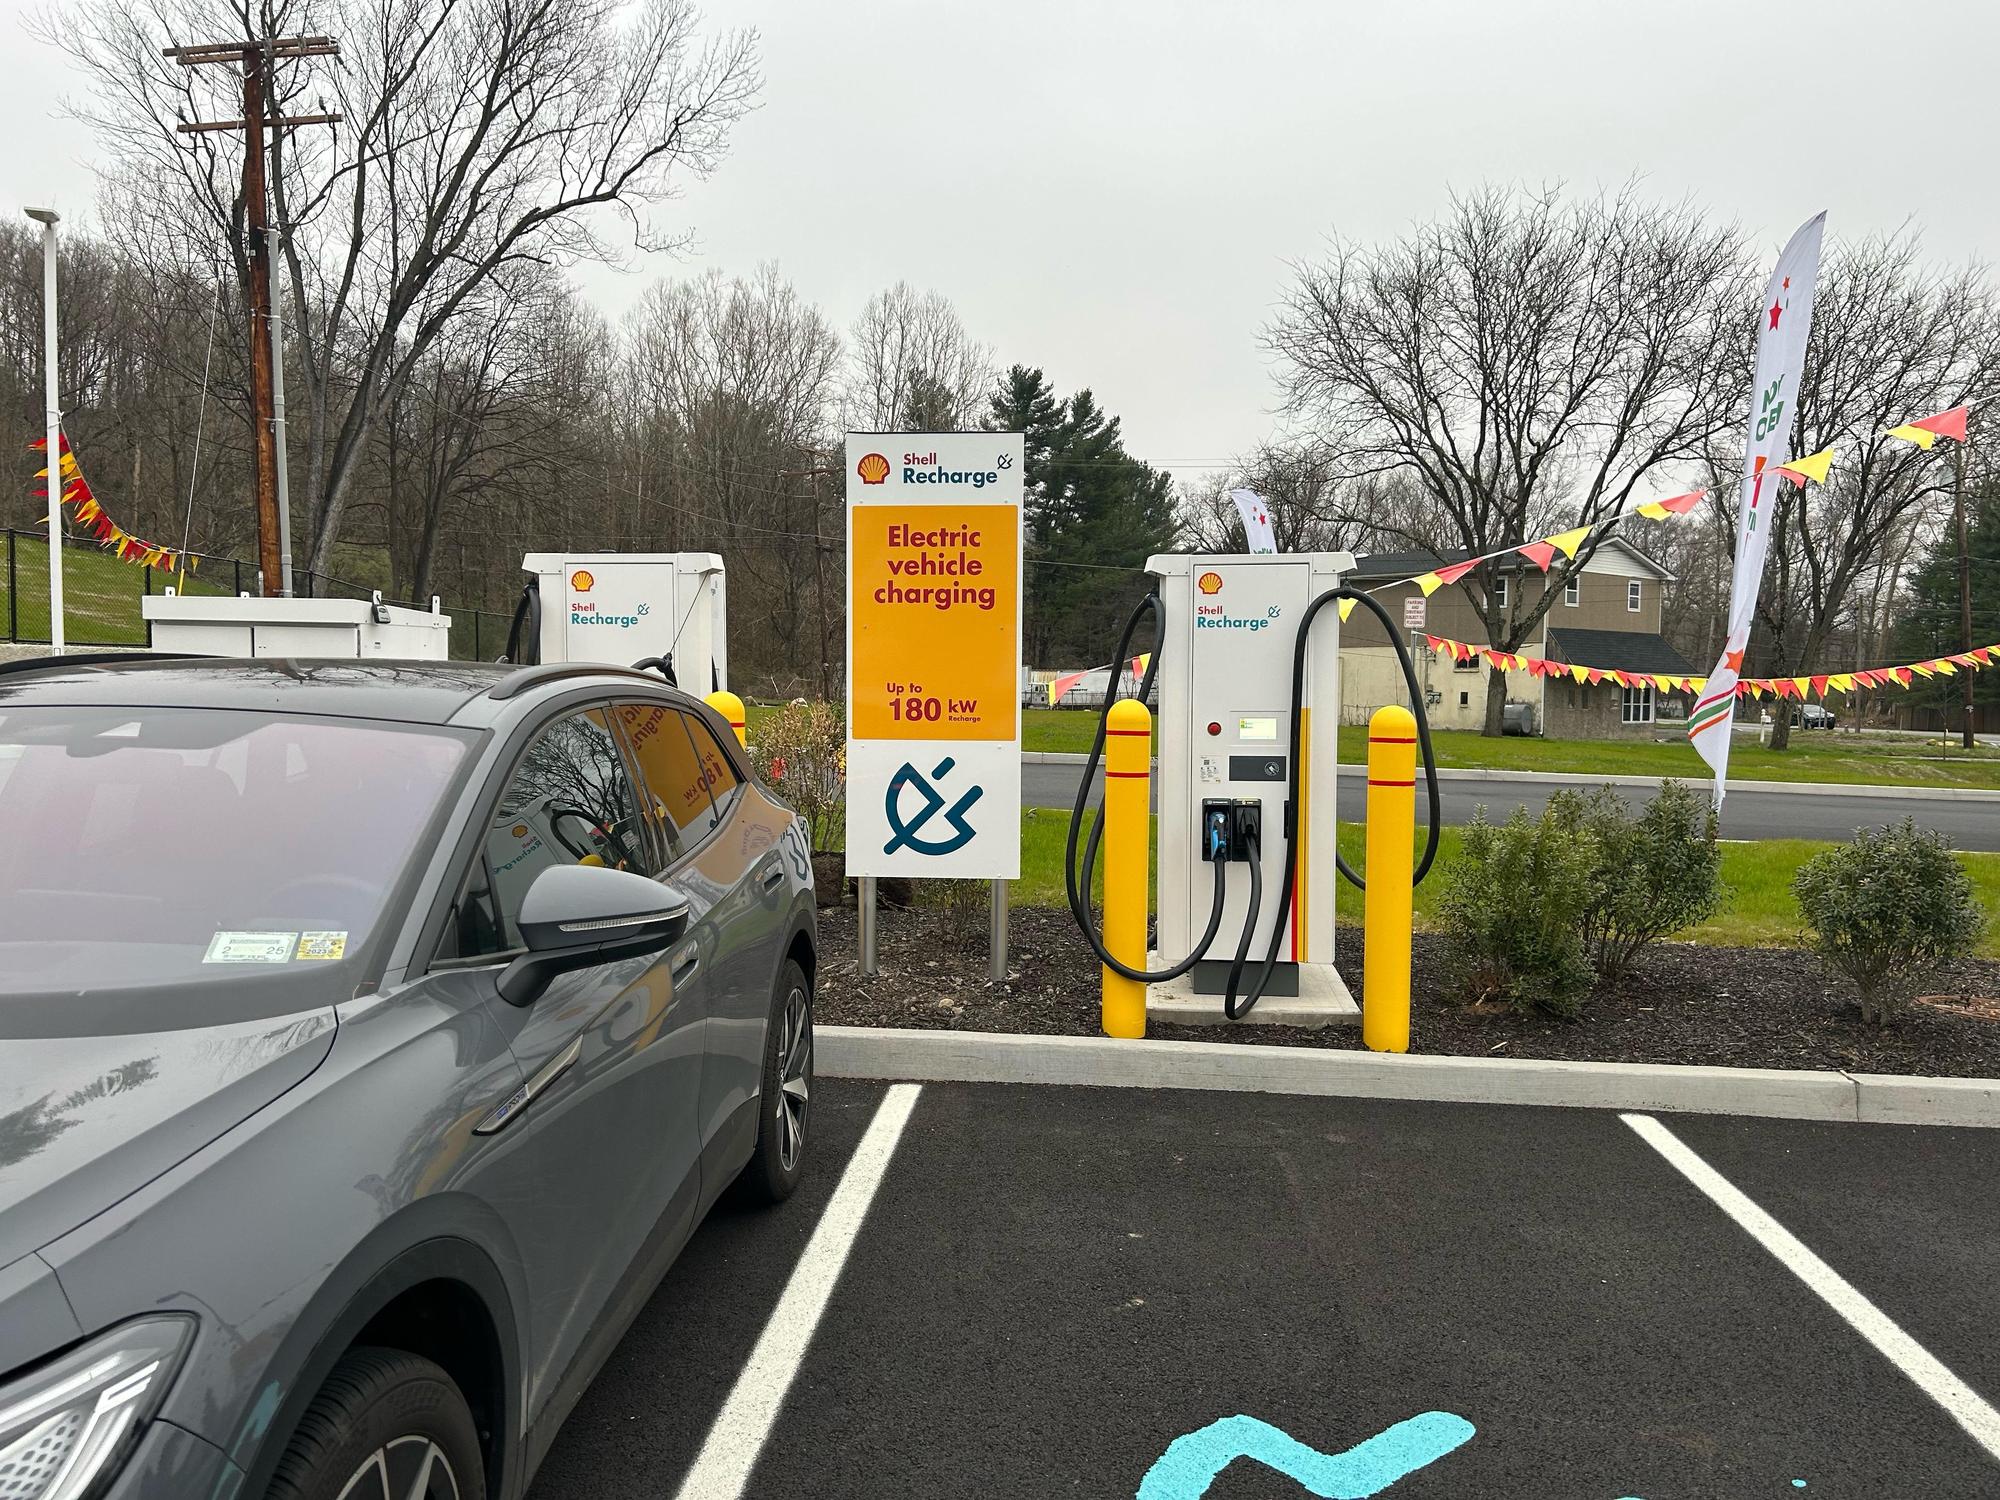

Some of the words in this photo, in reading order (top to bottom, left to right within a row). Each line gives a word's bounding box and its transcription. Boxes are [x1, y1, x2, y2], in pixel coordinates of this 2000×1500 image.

[903, 452, 937, 465] Shell
[903, 466, 998, 488] Recharge
[888, 523, 981, 548] Electric
[887, 552, 983, 576] vehicle
[874, 580, 996, 611] charging
[571, 602, 595, 612] Shell
[1197, 605, 1223, 615] Shell
[571, 612, 639, 628] Recharge
[1197, 615, 1269, 631] Recharge
[886, 682, 904, 696] Up
[909, 682, 922, 693] to
[889, 698, 942, 721] 180
[948, 699, 978, 713] kW
[948, 715, 981, 723] Recharge
